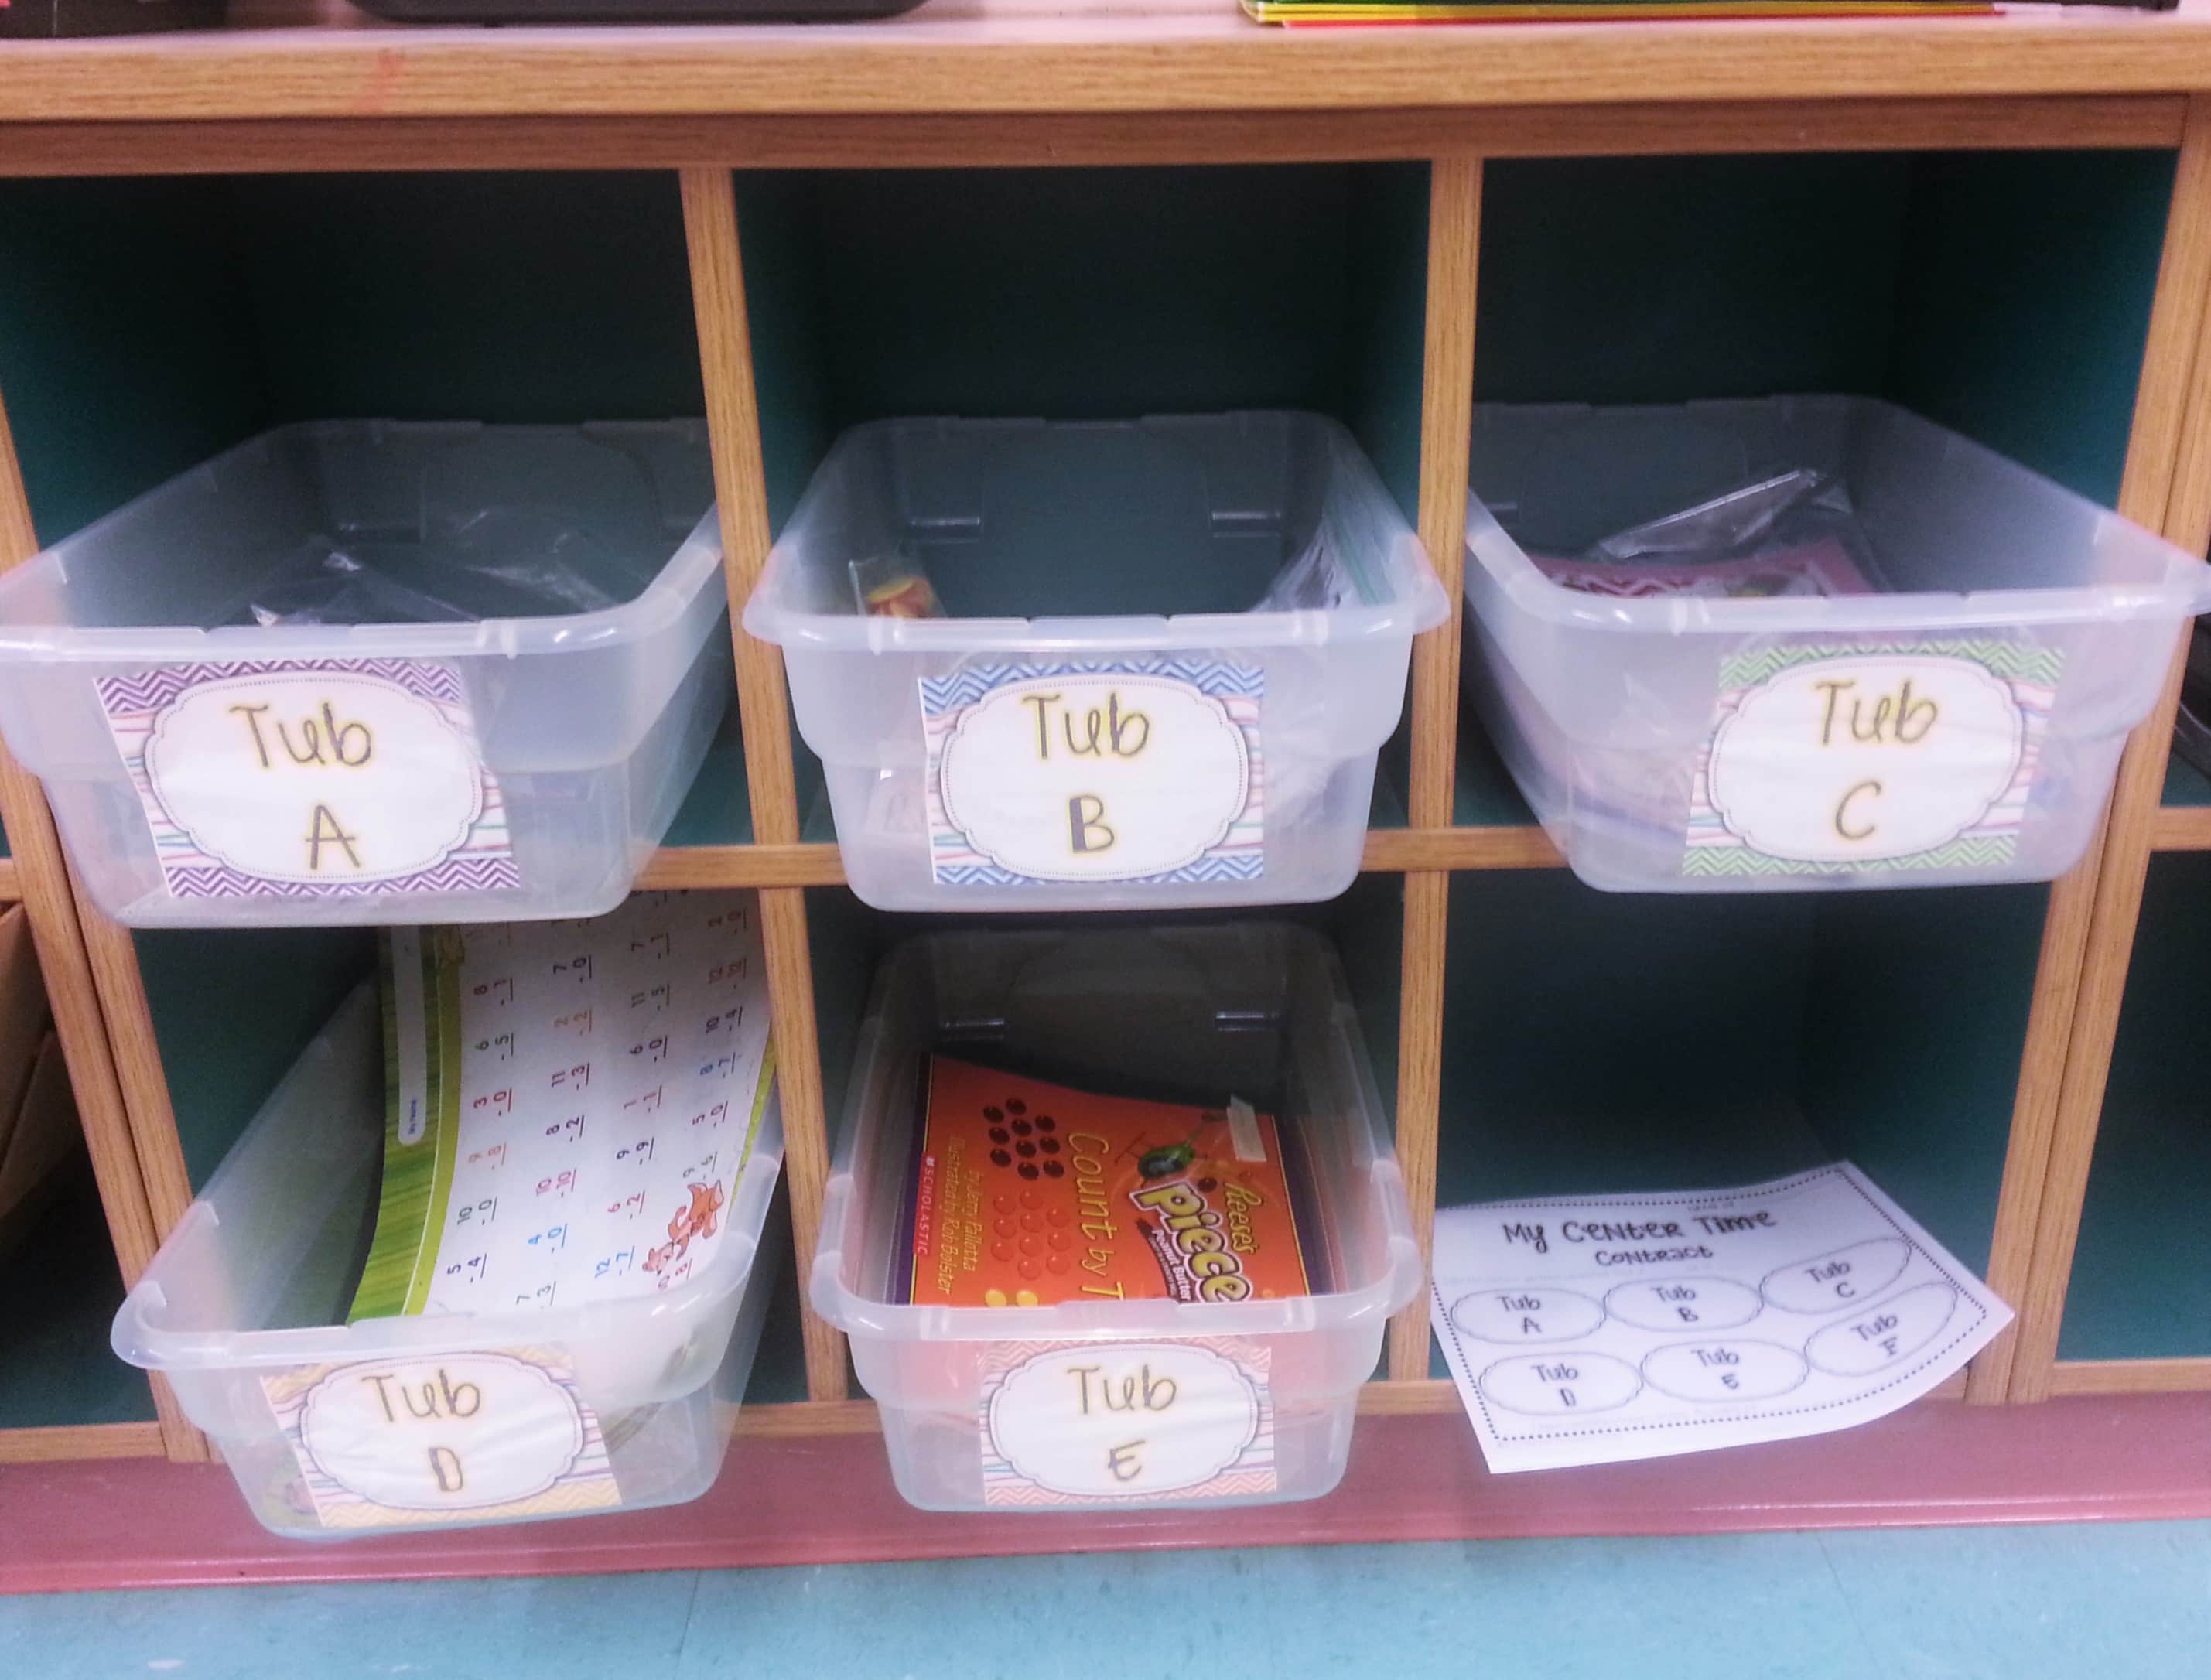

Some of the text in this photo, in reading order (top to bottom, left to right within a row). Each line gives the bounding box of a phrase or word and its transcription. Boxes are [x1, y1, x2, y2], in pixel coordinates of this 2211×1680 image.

[1814, 680, 1937, 746] Tub
[1022, 691, 1150, 760] Tub
[231, 702, 372, 770] Tub
[1836, 780, 1883, 842] C
[1069, 794, 1116, 854] B
[303, 804, 361, 871] A
[553, 964, 567, 975] 7
[473, 985, 488, 995] 8
[631, 992, 645, 1007] 11
[554, 1017, 568, 1028] 2
[706, 1016, 719, 1034] 10
[475, 1041, 489, 1050] 6
[630, 1045, 643, 1055] 6
[552, 1070, 566, 1088] 11
[700, 1064, 713, 1076] 8
[473, 1097, 488, 1108] 3
[692, 1114, 706, 1125] 5
[546, 1124, 560, 1135] 8
[468, 1152, 483, 1163] 9
[617, 1150, 630, 1159] 9
[535, 1178, 552, 1197] 10
[1068, 1132, 1118, 1241] Count
[607, 1203, 620, 1213] 6
[962, 1185, 983, 1217] Jerry
[457, 1207, 473, 1225] 10
[917, 1168, 935, 1255] SCHOLASTIC
[1225, 1182, 1262, 1254] Reese's
[528, 1234, 541, 1245] 4
[940, 1218, 960, 1243] Rob
[1502, 1221, 1547, 1253] My
[963, 1222, 982, 1271] Pallotta
[447, 1264, 462, 1275] 5
[595, 1258, 610, 1279] 12
[938, 1244, 959, 1295] Bolster
[1081, 1248, 1115, 1276] by
[1152, 1230, 1180, 1265] Peanut
[1173, 1265, 1191, 1301] Butter
[1804, 1261, 1851, 1284] Tub
[516, 1295, 530, 1305] 7
[1651, 1284, 1697, 1303] Tub
[1836, 1282, 1855, 1299] C
[1496, 1294, 1542, 1313] Tub
[1676, 1306, 1699, 1323] B
[1521, 1316, 1543, 1334] A
[1850, 1315, 1898, 1342] Tub
[1879, 1337, 1898, 1357] F
[1692, 1347, 1740, 1367] Tub
[1530, 1363, 1578, 1382] Tub
[1721, 1373, 1740, 1390] E
[362, 1370, 480, 1422] Tub
[1066, 1364, 1177, 1415] Tub
[1559, 1387, 1577, 1408] D
[430, 1447, 463, 1492] D
[1107, 1439, 1148, 1481] E
